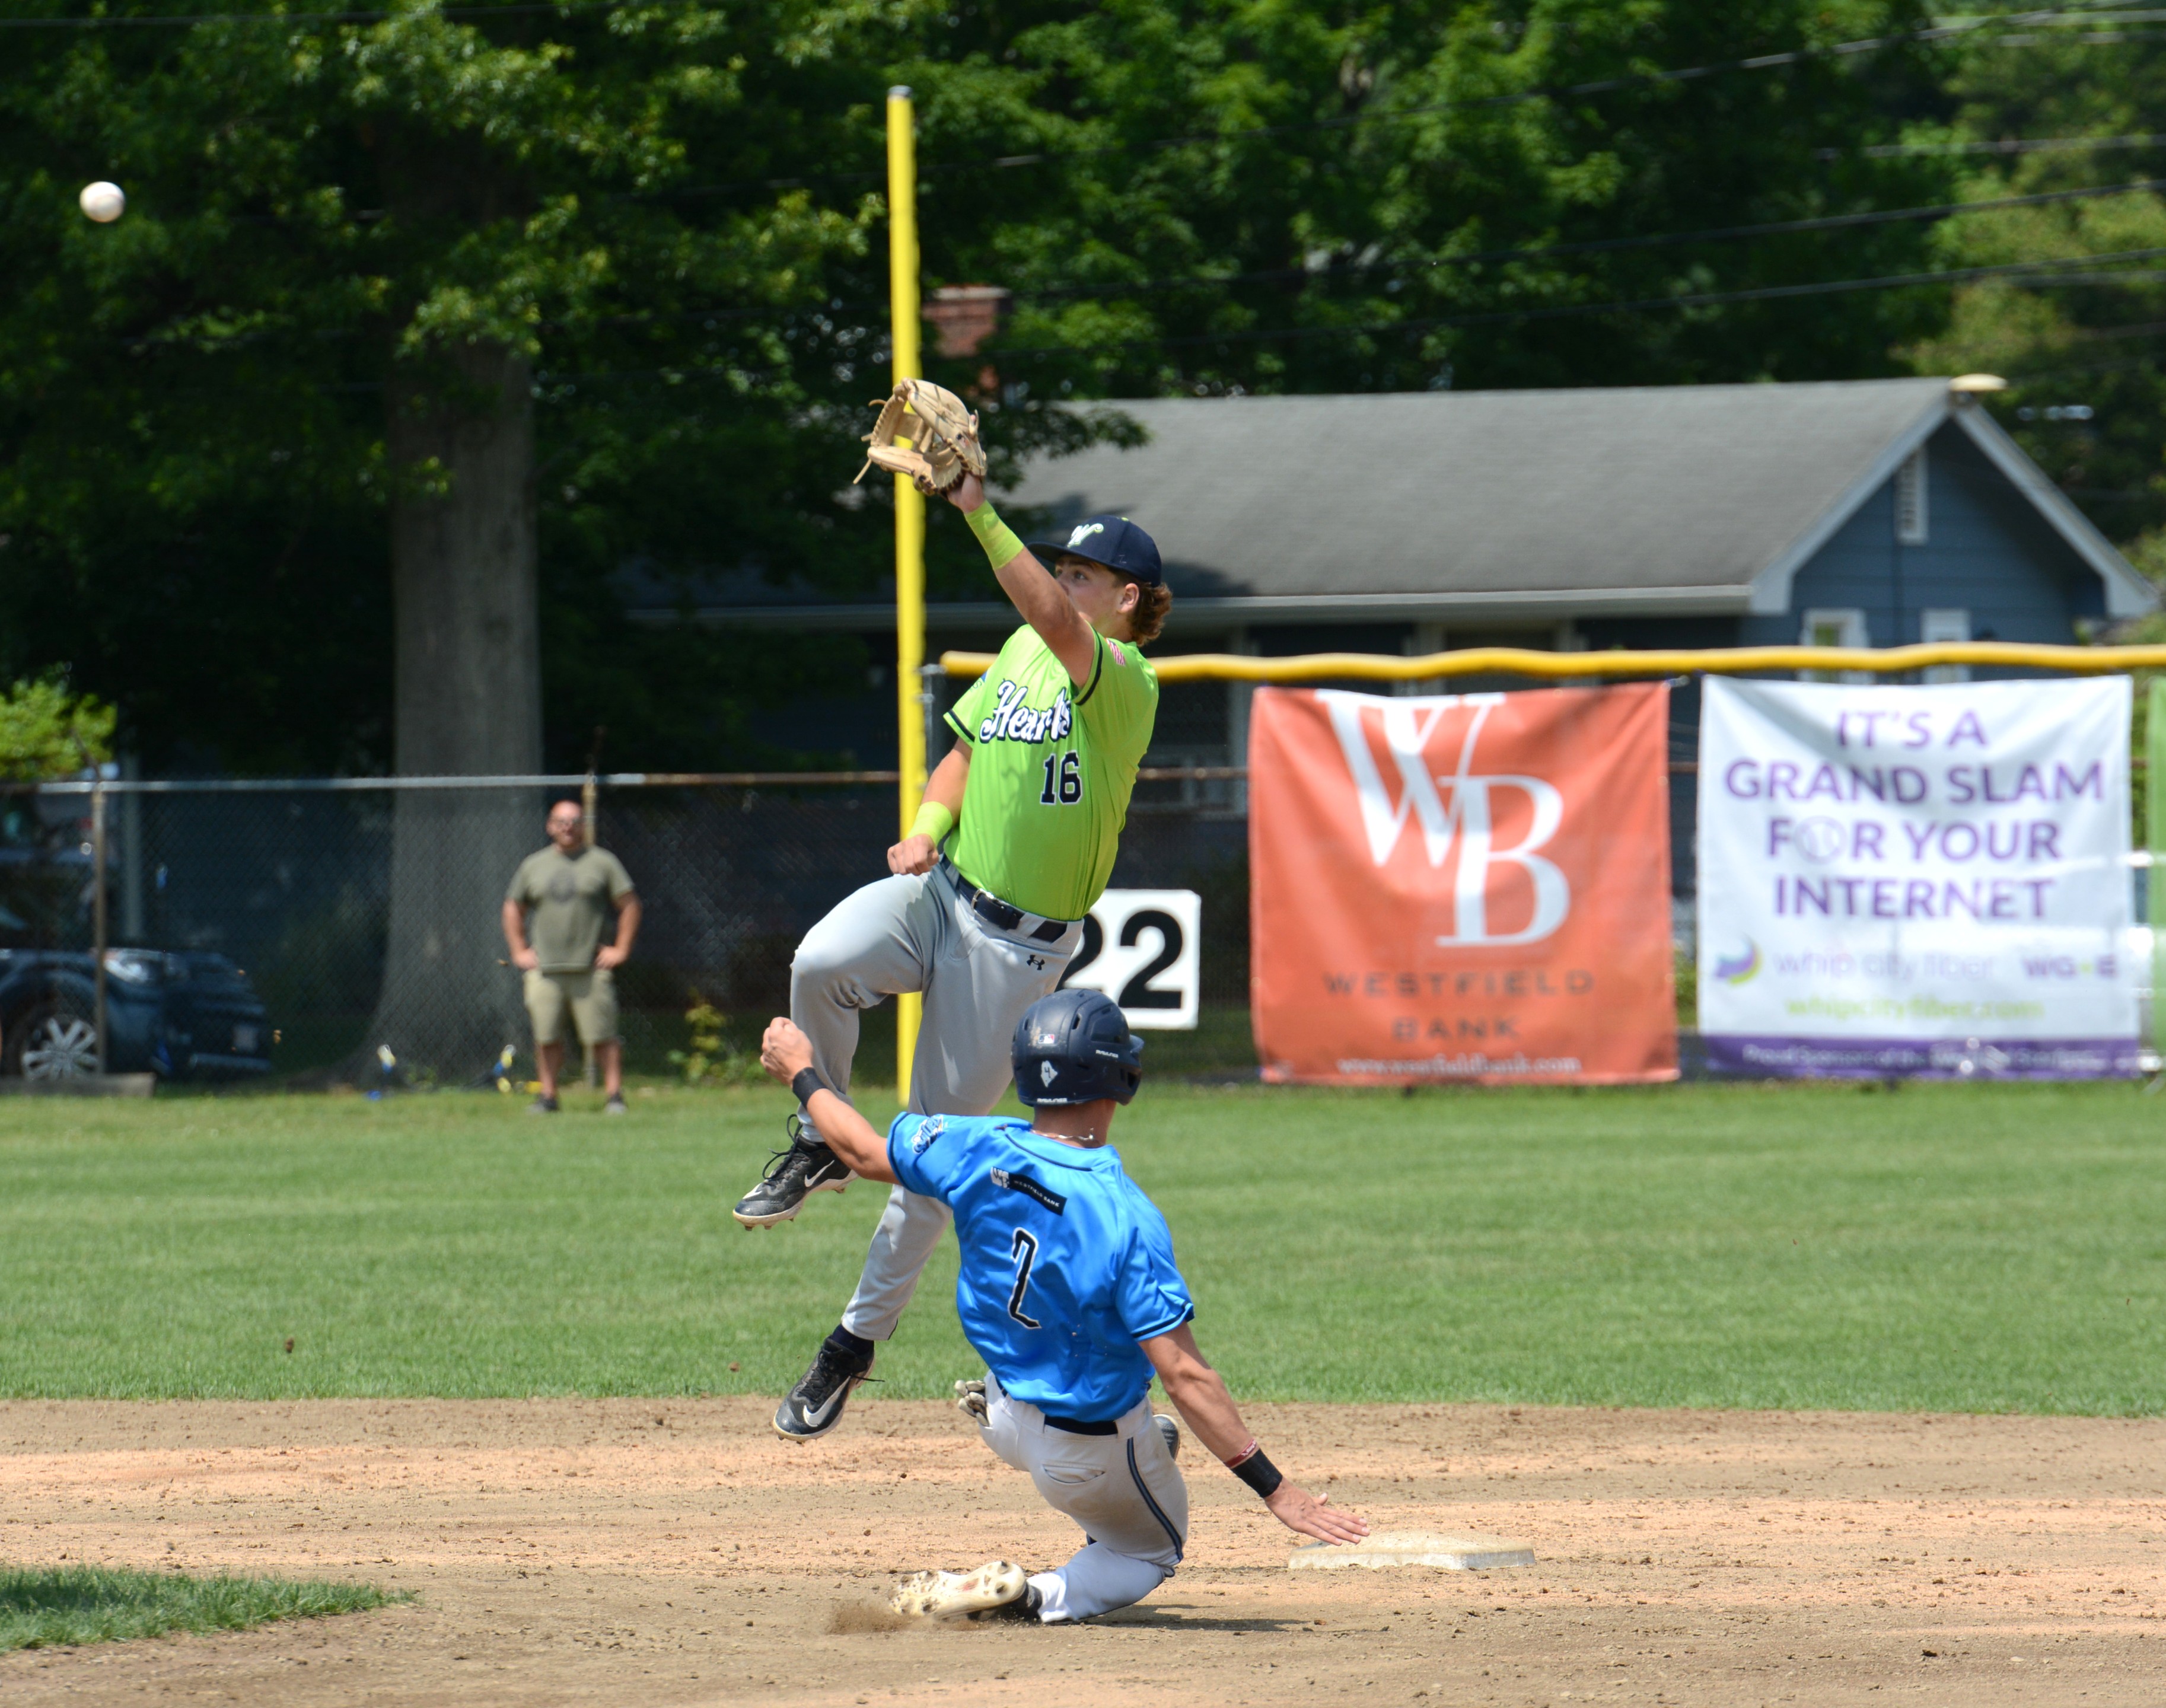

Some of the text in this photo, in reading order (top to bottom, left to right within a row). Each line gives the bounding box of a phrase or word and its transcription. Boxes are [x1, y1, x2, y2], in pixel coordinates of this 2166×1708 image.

[979, 678, 1072, 744] Hearts
[1837, 709, 1987, 749] IT'S A
[1040, 750, 1082, 805] 16
[1725, 760, 2104, 805] GRAND SLAM
[1901, 820, 2061, 862] YOUR
[1774, 877, 2056, 919] INTERNET
[1323, 969, 1594, 998] WESTFIELD
[1391, 1016, 1520, 1043] BANK
[1014, 1180, 1060, 1207] WESTFIELD BANK
